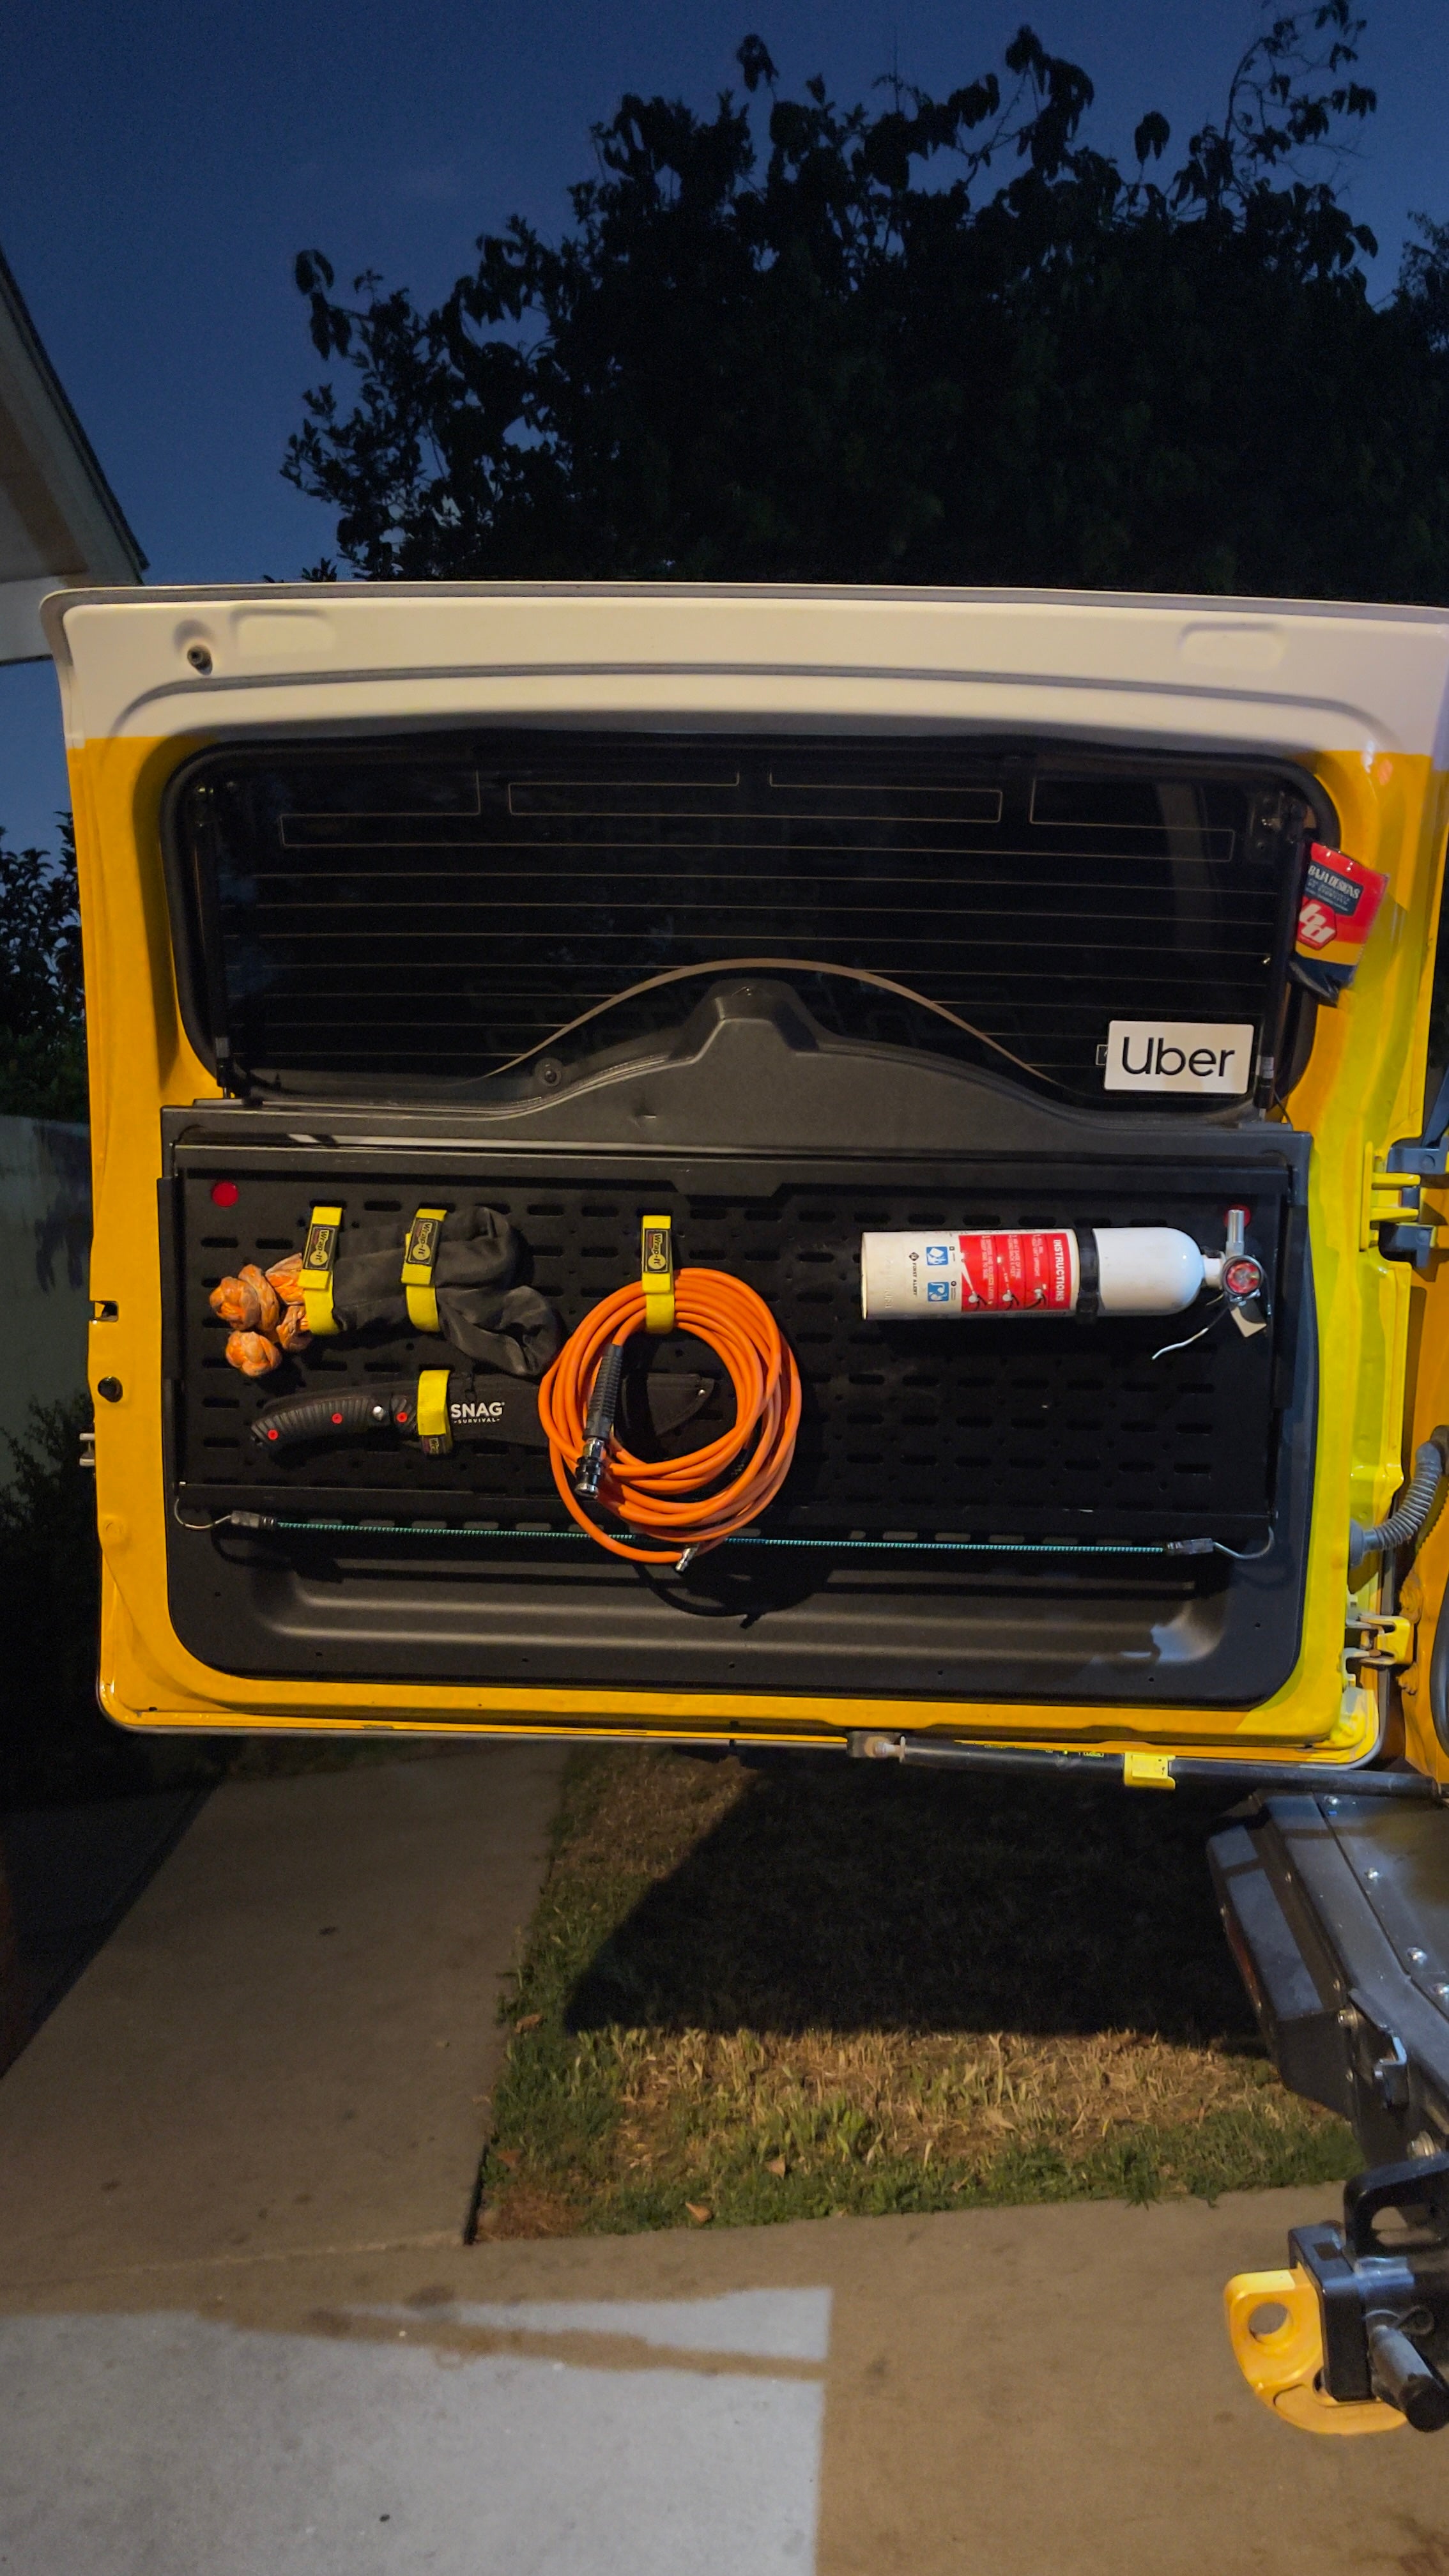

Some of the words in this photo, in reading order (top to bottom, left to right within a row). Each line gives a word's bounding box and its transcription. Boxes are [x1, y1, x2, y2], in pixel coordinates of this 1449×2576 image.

[1122, 1036, 1235, 1077] Uber
[1054, 1239, 1064, 1301] INSTRUCTIONS
[450, 1402, 502, 1418] SNAG
